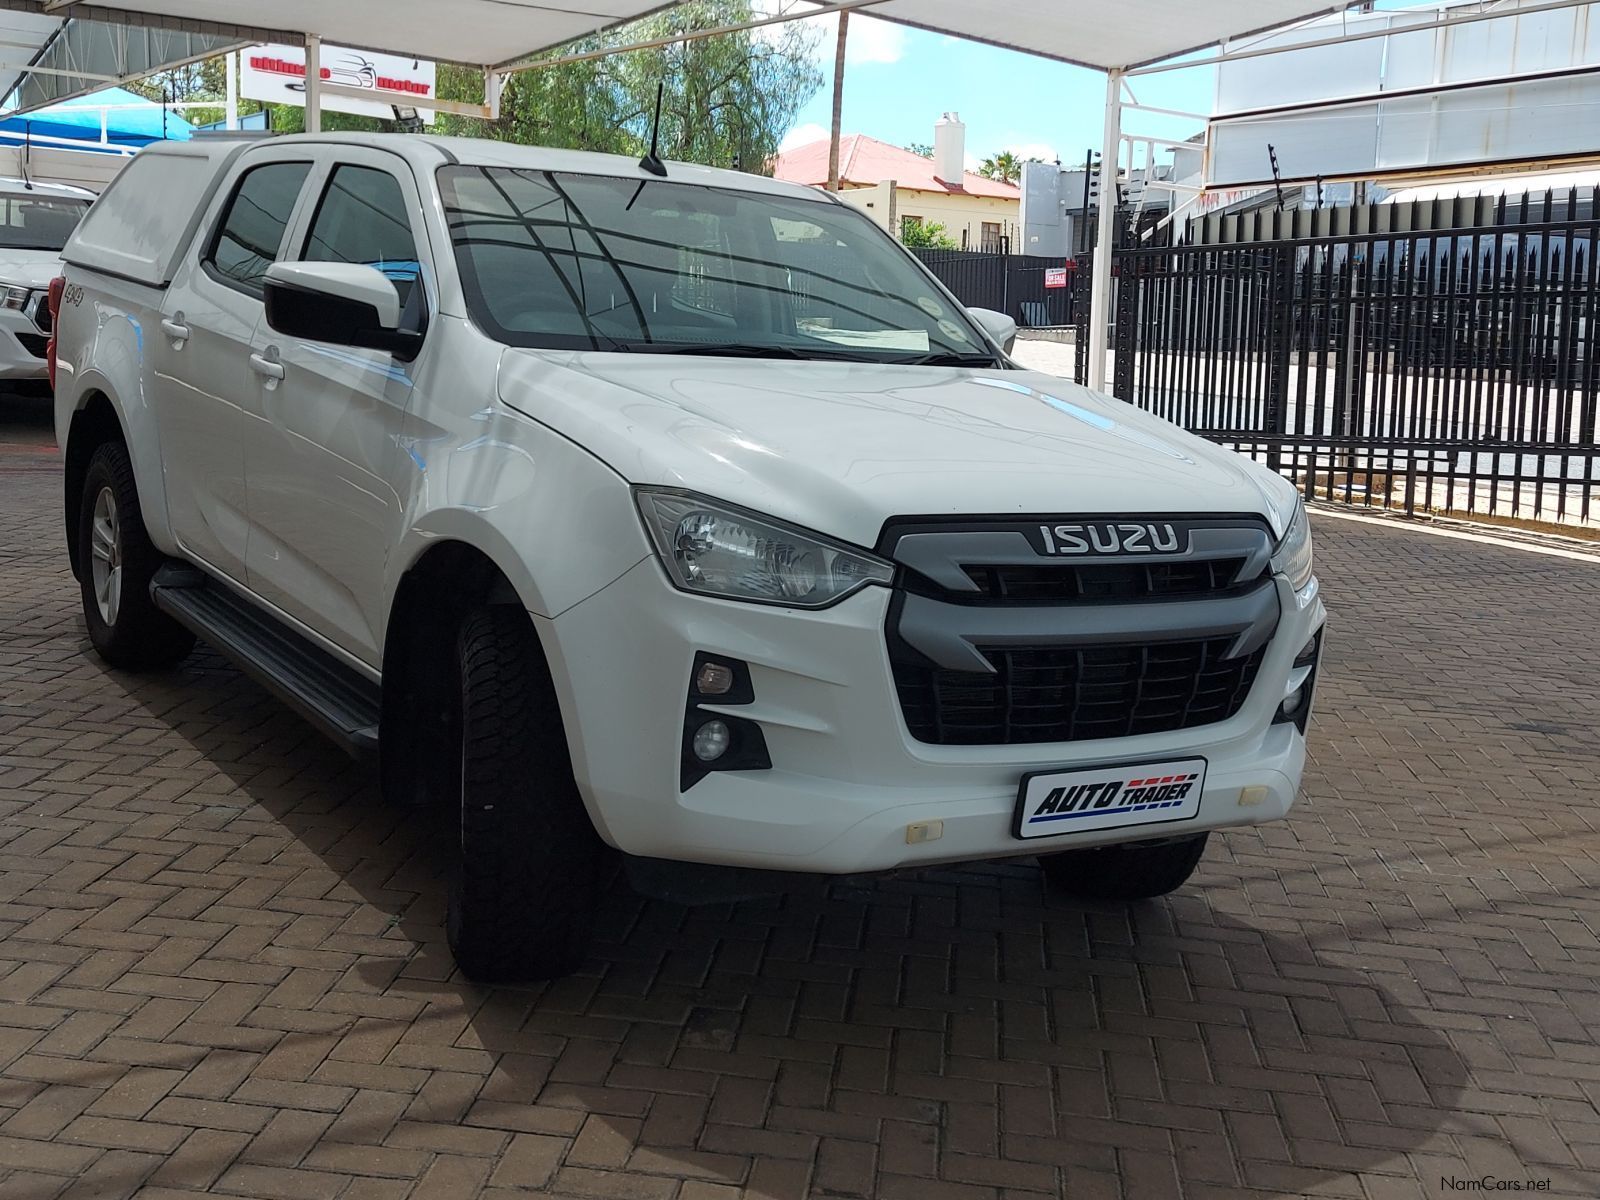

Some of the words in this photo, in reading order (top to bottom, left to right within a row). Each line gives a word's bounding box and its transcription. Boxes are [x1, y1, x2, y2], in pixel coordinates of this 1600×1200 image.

[377, 77, 430, 95] motor
[1039, 524, 1178, 554] ISUZU
[1033, 781, 1125, 816] AUTO
[1118, 782, 1193, 807] TRADER
